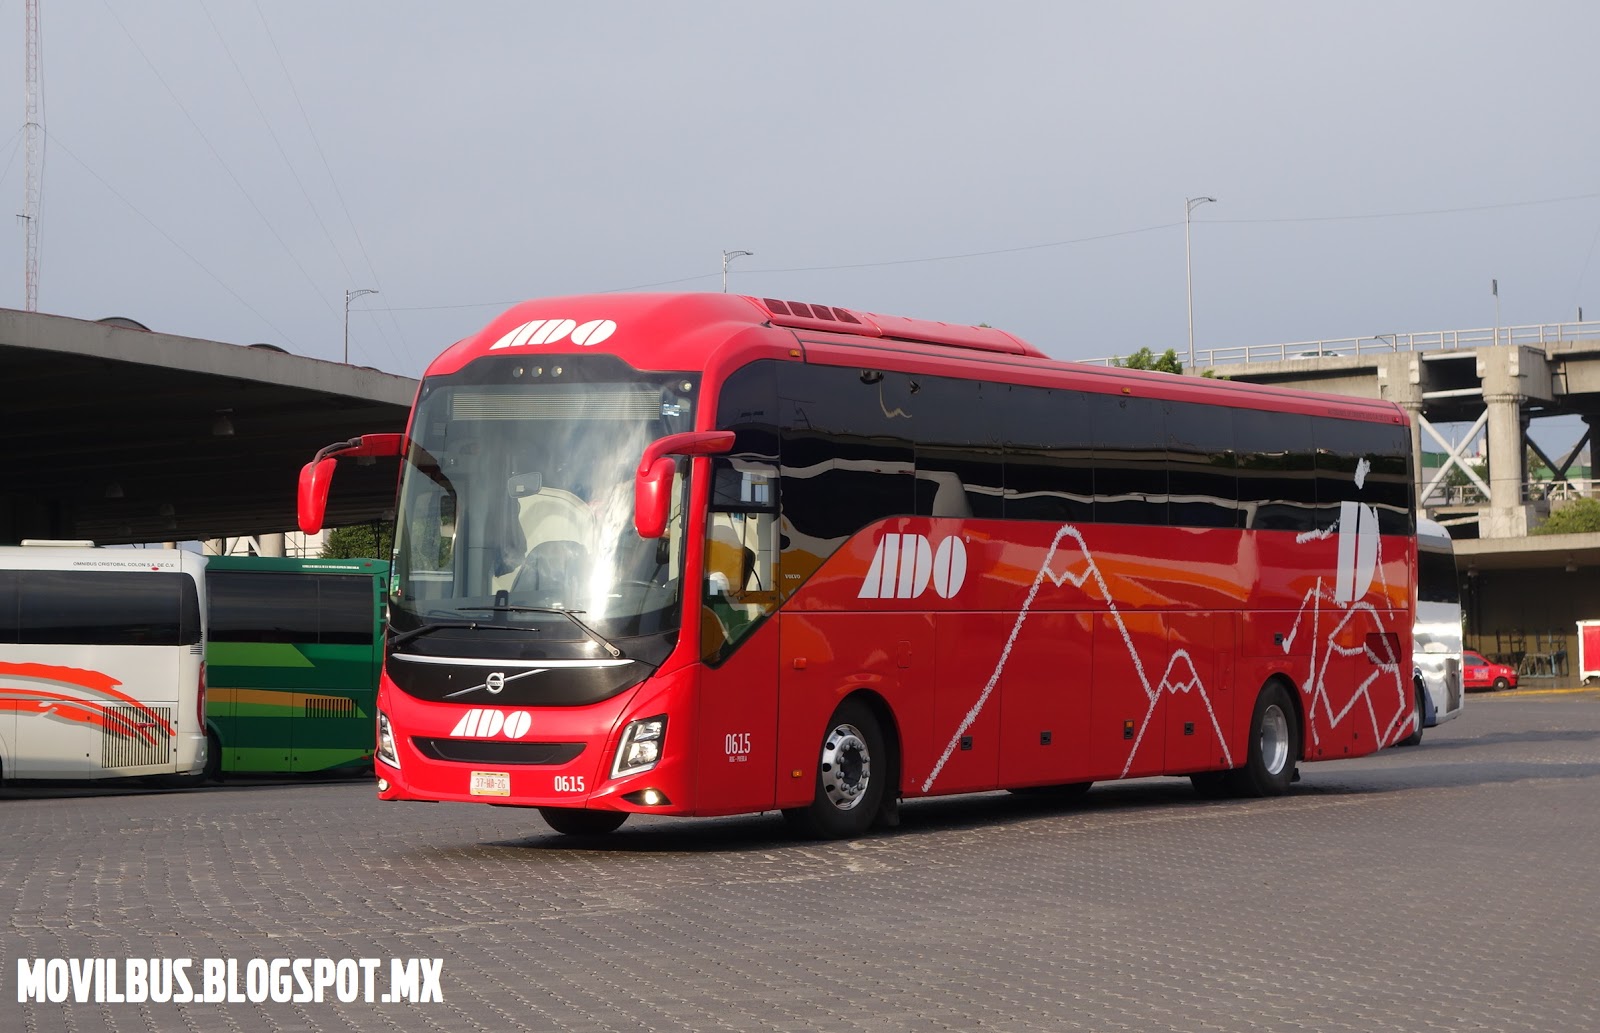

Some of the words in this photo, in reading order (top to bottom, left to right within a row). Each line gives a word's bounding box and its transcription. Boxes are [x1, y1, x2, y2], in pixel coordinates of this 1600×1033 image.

[489, 319, 617, 350] ADO
[857, 533, 967, 599] ADO
[449, 708, 532, 739] ADO
[725, 733, 751, 755] 0615
[554, 775, 585, 792] 0615
